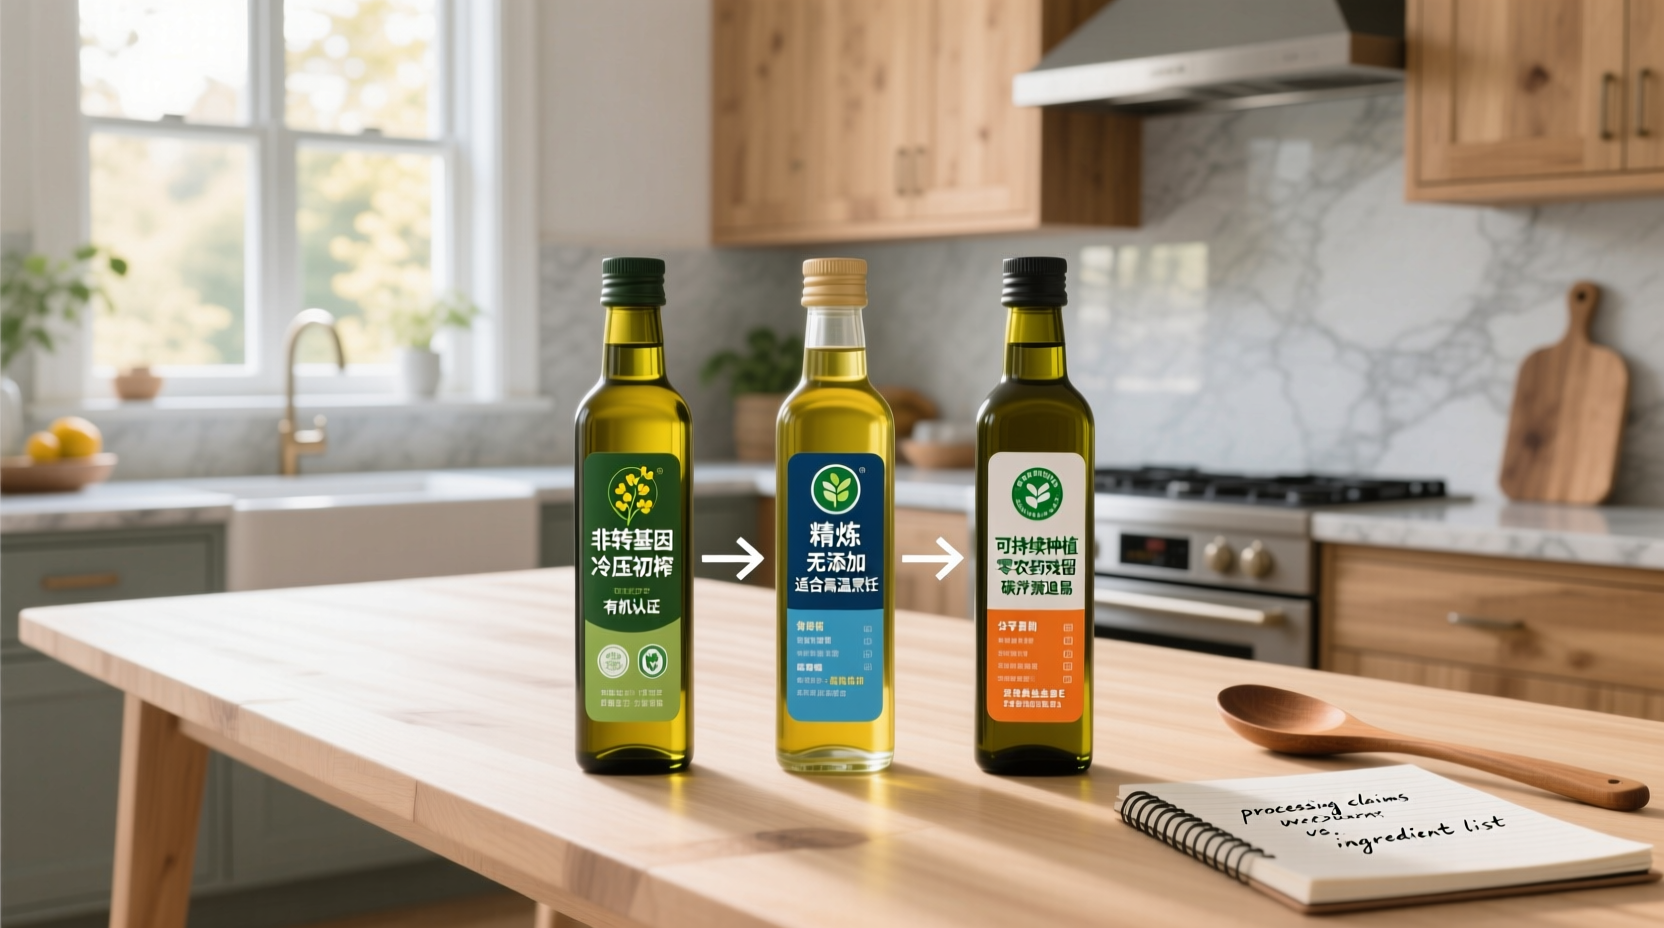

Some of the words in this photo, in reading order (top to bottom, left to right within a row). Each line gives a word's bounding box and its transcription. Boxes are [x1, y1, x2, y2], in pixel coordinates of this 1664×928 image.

[591, 528, 674, 551] 非转基因
[809, 521, 861, 547] 精炼
[995, 535, 1079, 555] 可持续种植
[591, 555, 674, 578] 冷压初榨
[807, 551, 866, 573] 无添加
[1241, 800, 1342, 824] processing
[1348, 793, 1409, 807] claims
[1337, 822, 1455, 855] ingredient
[1464, 815, 1506, 832] list
